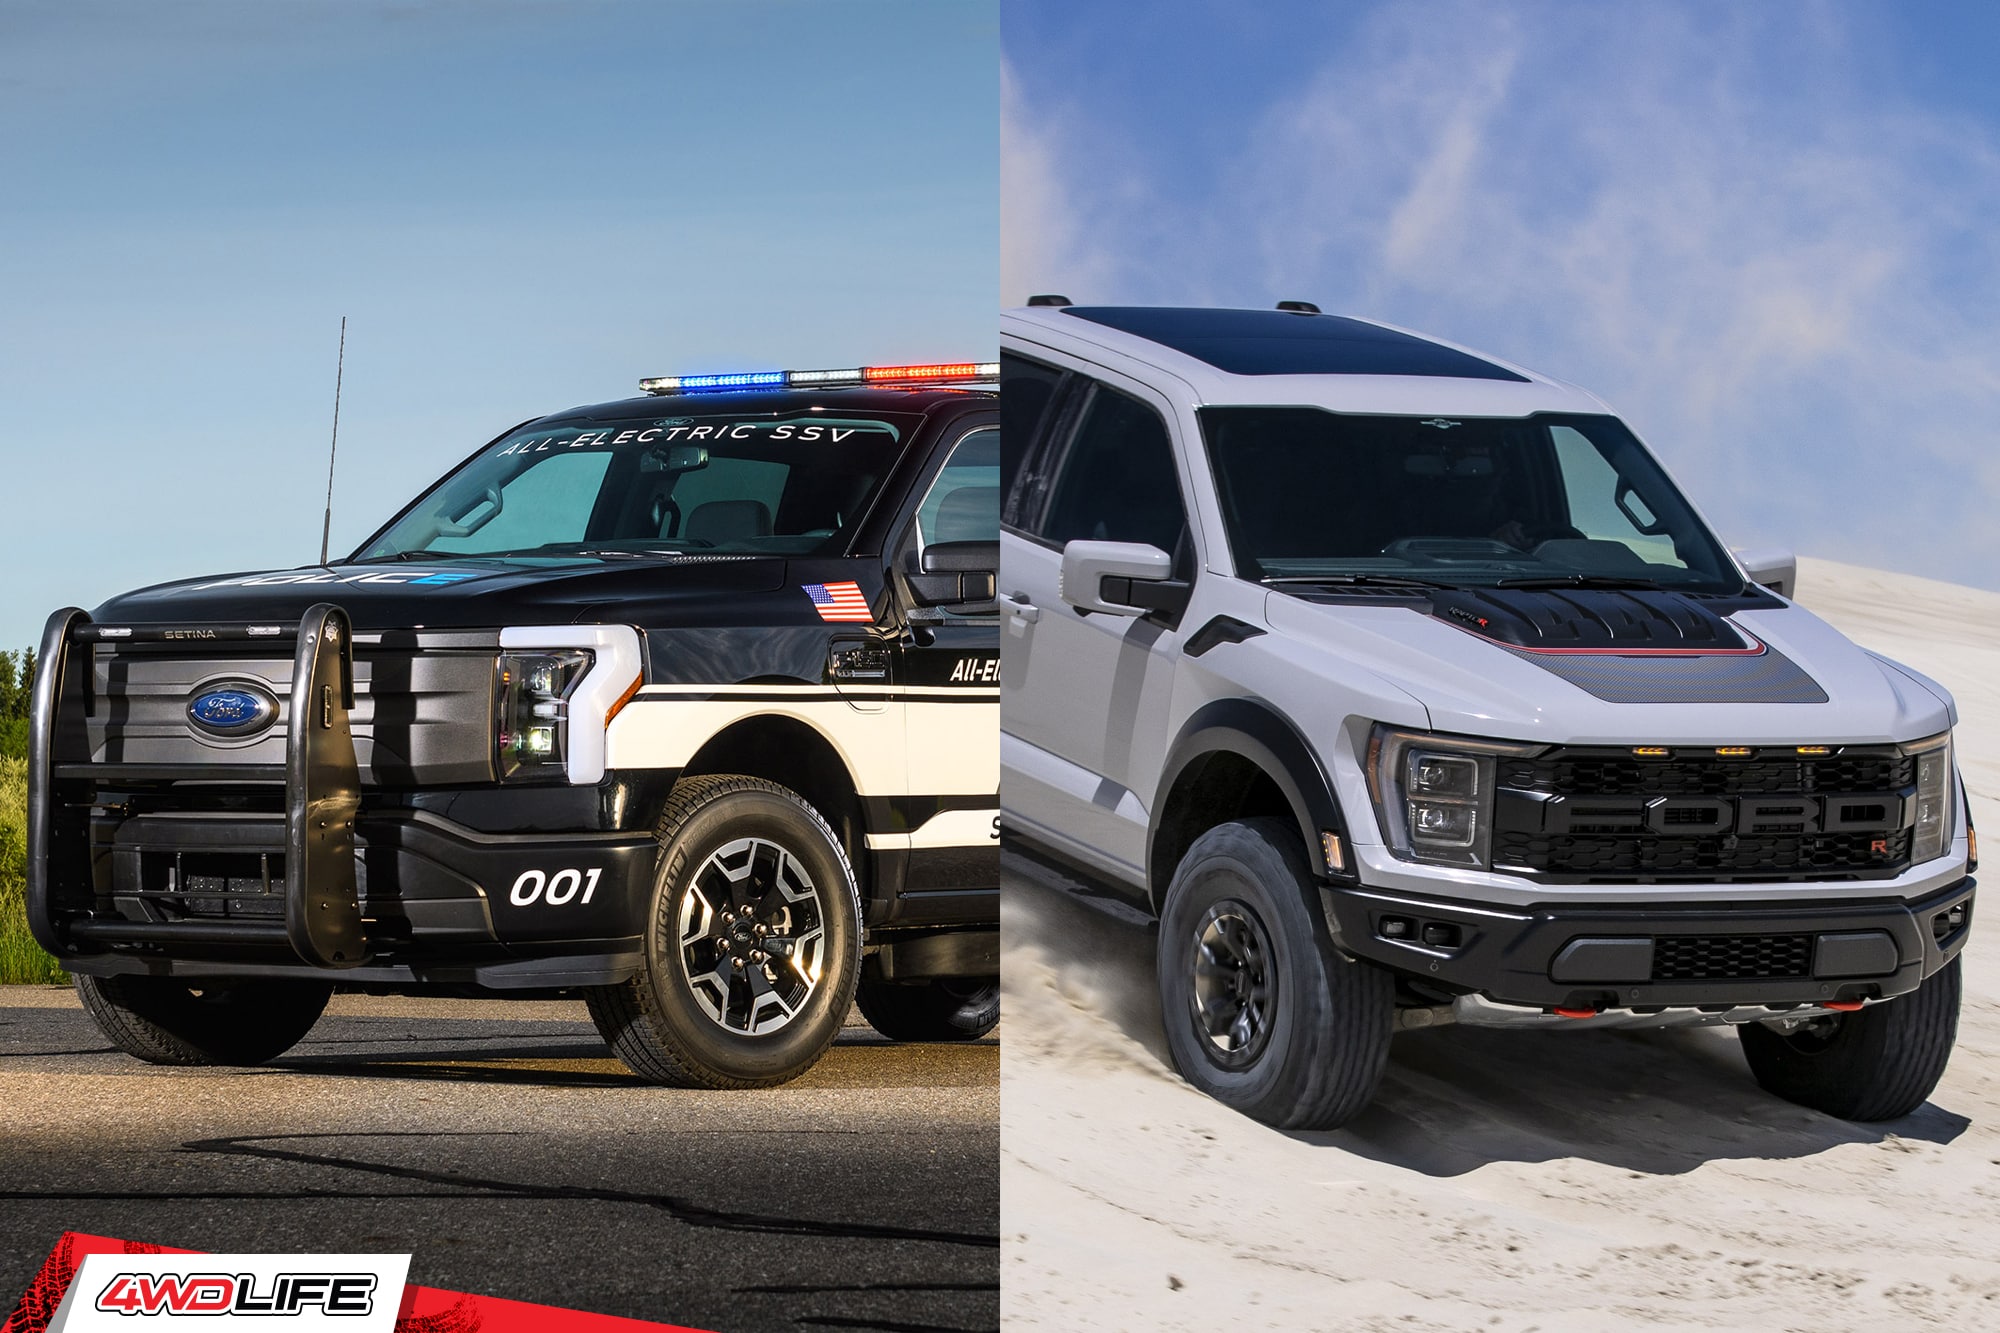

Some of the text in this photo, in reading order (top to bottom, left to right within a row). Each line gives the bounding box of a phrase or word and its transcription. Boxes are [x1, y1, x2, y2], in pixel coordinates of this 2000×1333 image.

[497, 425, 855, 457] ALL-ELECTRIC SSV
[164, 630, 216, 639] SETINA
[949, 658, 1000, 681] All-El
[204, 697, 246, 719] Ford
[1545, 795, 1903, 834] FORD
[510, 868, 602, 906] 001
[658, 854, 685, 953] MICHELIN
